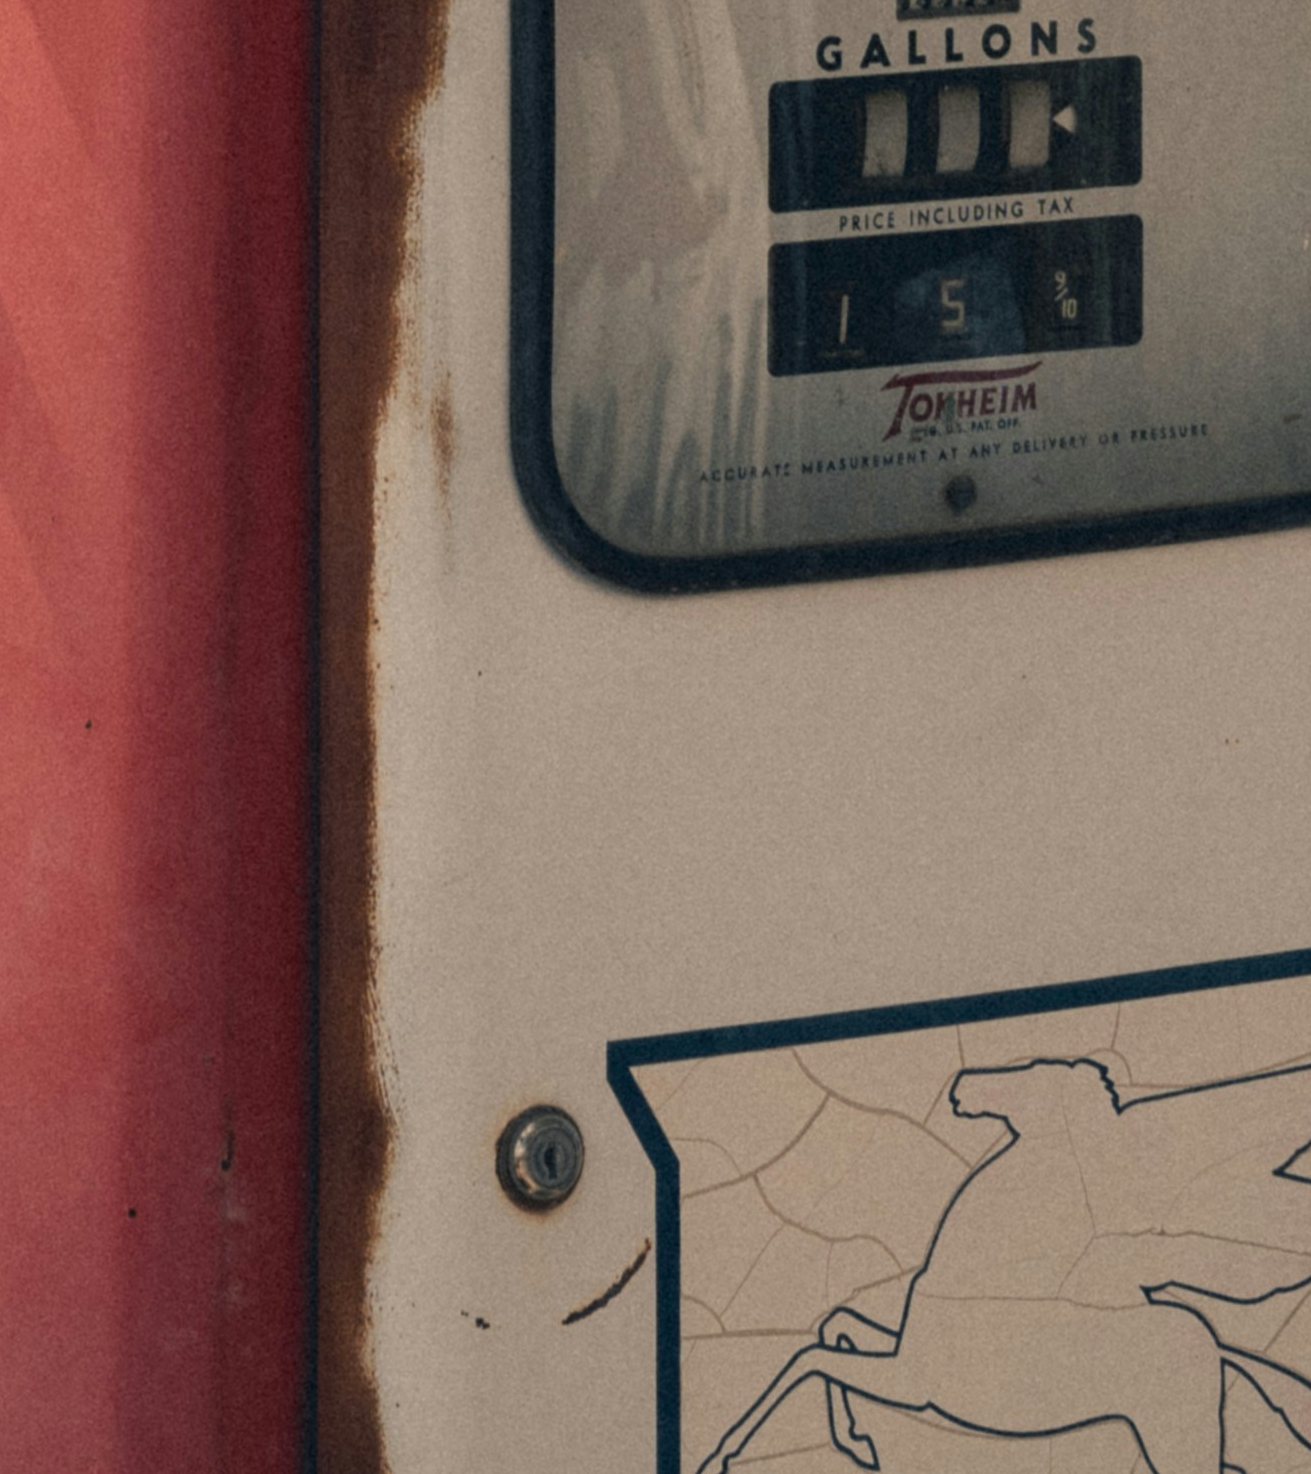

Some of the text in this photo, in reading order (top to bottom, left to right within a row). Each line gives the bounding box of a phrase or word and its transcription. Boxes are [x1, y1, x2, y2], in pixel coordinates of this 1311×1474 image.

[815, 18, 1097, 71] GALLONS
[839, 196, 1075, 232] PRICE INCLUDING TAX
[940, 280, 966, 330] 5
[880, 360, 1042, 442] TOKHEIM
[699, 423, 1209, 483] ACCURATE MEASUREMENT AT ANY DELIVERY OR PRESSURE
